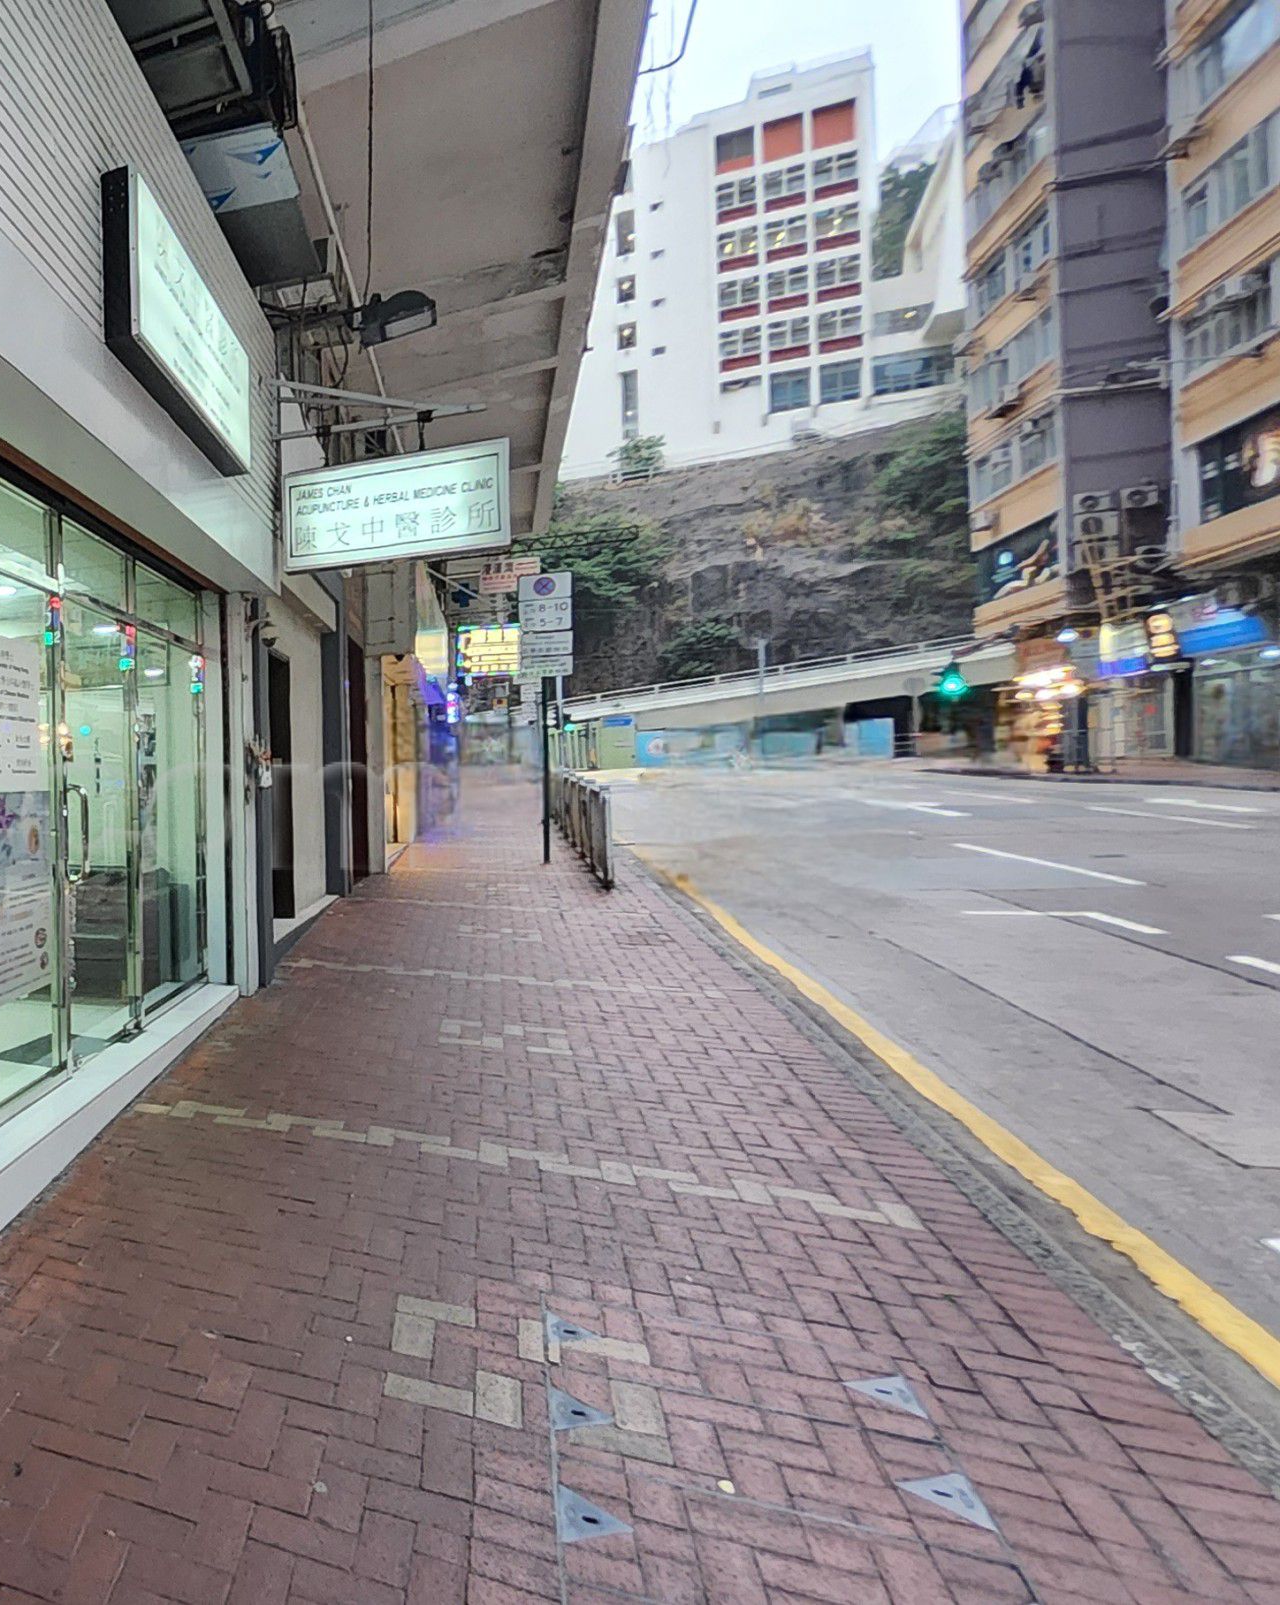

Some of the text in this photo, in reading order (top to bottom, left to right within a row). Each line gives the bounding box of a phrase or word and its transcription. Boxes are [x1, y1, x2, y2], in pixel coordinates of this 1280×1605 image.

[296, 484, 352, 501] JAMES CHAN
[296, 477, 494, 516] ACUPUNCTURE & HERBAL MEDICINE CLINIC
